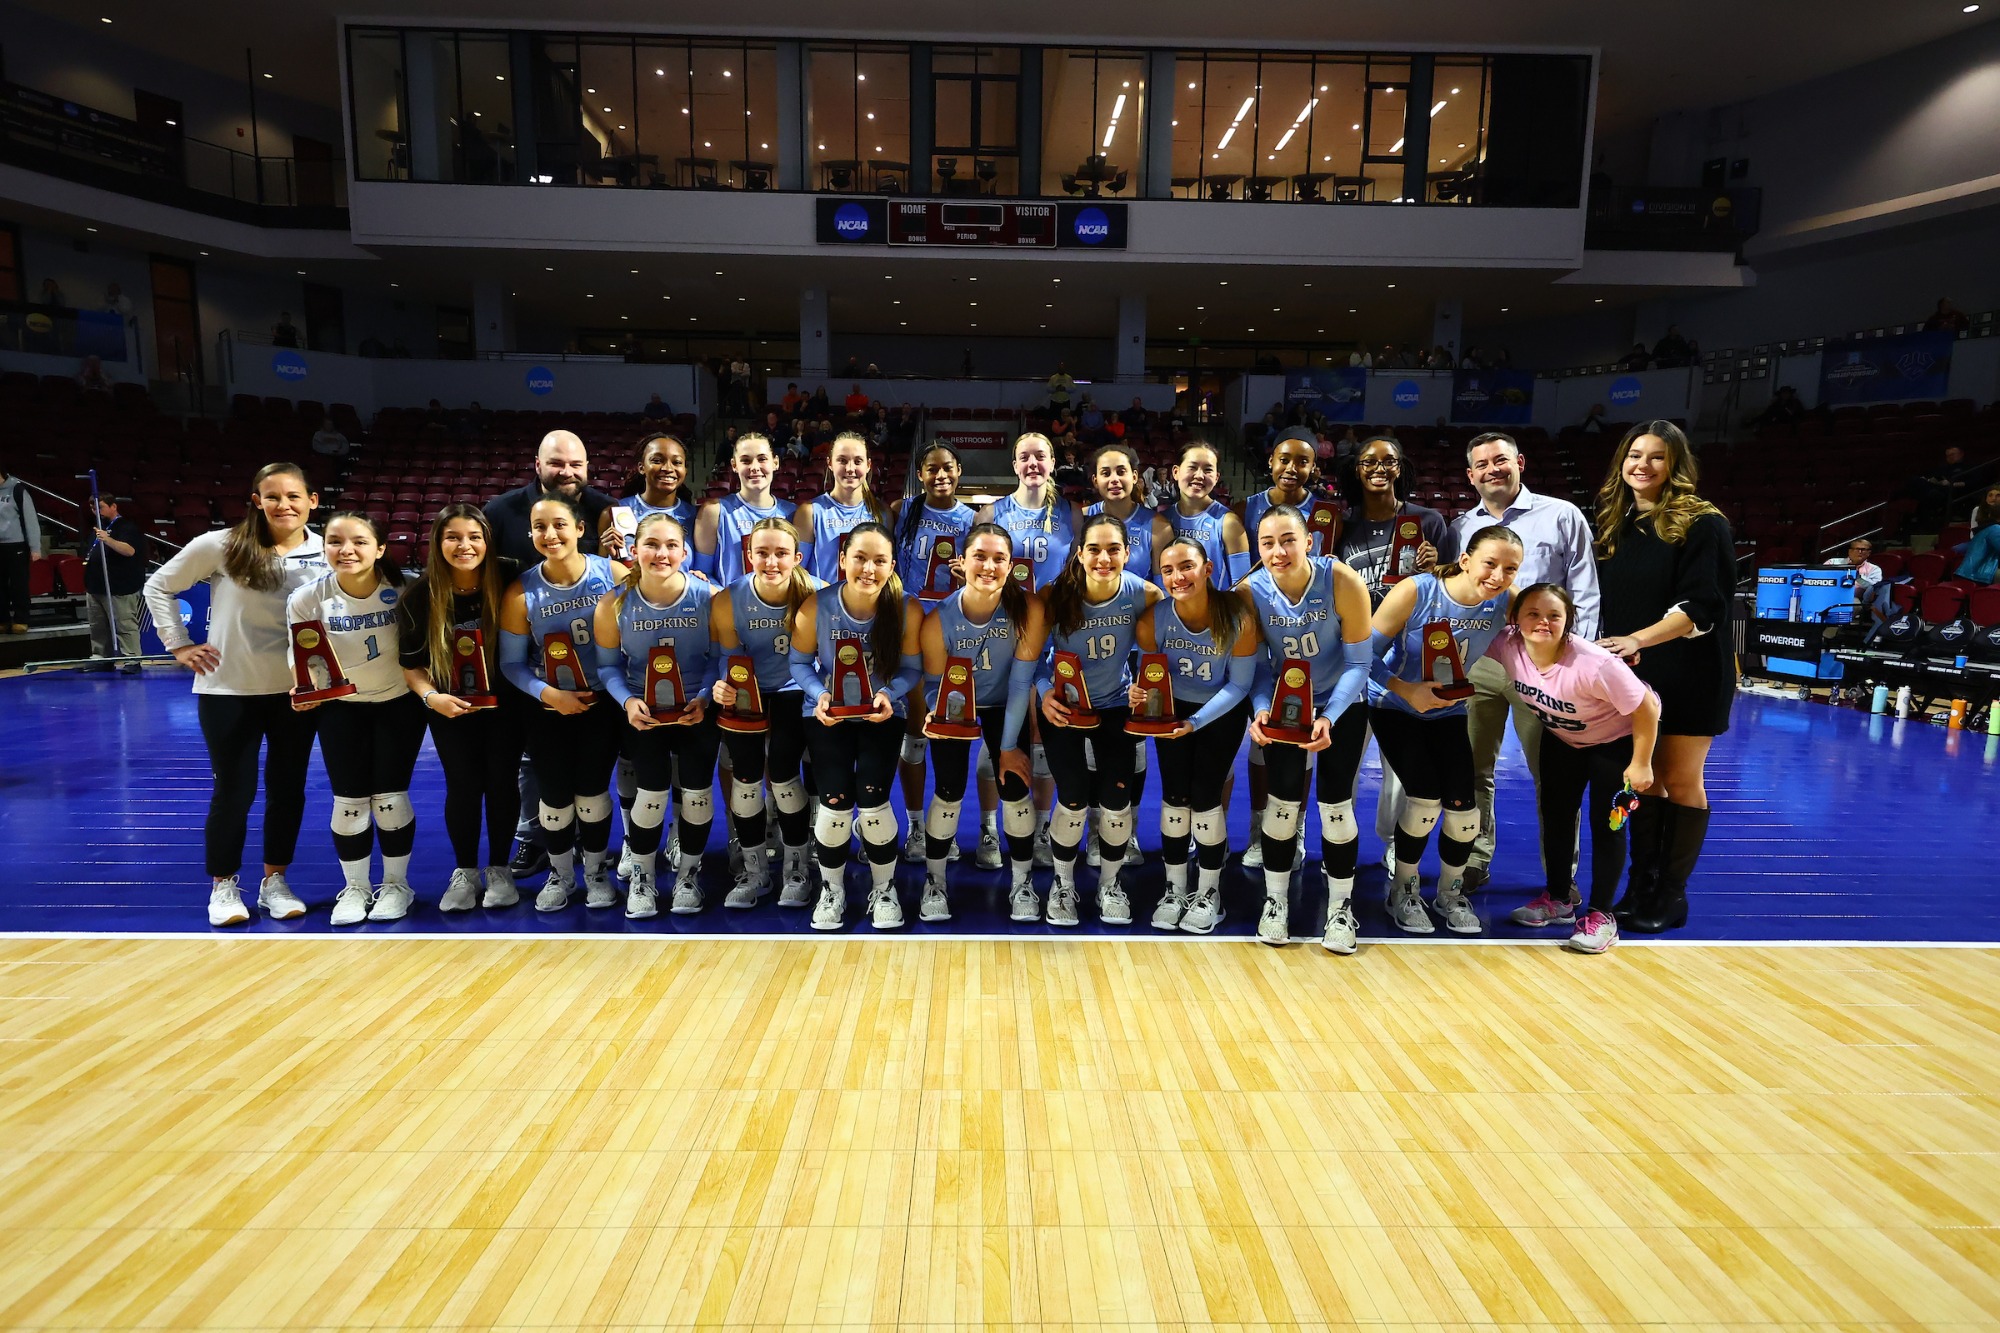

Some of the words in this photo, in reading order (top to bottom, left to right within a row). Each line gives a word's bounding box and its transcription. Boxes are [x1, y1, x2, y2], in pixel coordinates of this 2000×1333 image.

[900, 204, 927, 214] HOME
[1015, 206, 1050, 217] VISITOR
[838, 220, 869, 231] NCAA
[1078, 224, 1108, 235] NCAA
[276, 364, 308, 376] NCAA
[529, 379, 554, 388] NCAA
[1395, 393, 1420, 402] NCAA
[1612, 390, 1642, 400] NCAA
[950, 436, 993, 444] RESTROOMS
[918, 518, 960, 536] OPKINS
[1007, 519, 1060, 532] HOPKIS
[1178, 529, 1210, 541] PKINS
[1022, 536, 1049, 564] 16
[328, 608, 401, 633] HOPKIN
[632, 617, 698, 631] HOPKINS
[1080, 614, 1131, 630] OPKINS
[1268, 610, 1328, 628] HOPKINS
[570, 618, 591, 645] 6
[364, 634, 381, 661] 1
[774, 634, 790, 655] 8
[1086, 634, 1116, 660] 19
[1164, 639, 1222, 656] HOPKIN
[1283, 631, 1320, 660] 20
[1431, 638, 1449, 646] NCAA
[1760, 634, 1805, 648] POWERADE
[550, 648, 568, 656] NCAA
[1178, 658, 1212, 681] 24
[1514, 680, 1577, 714] HOPKINS
